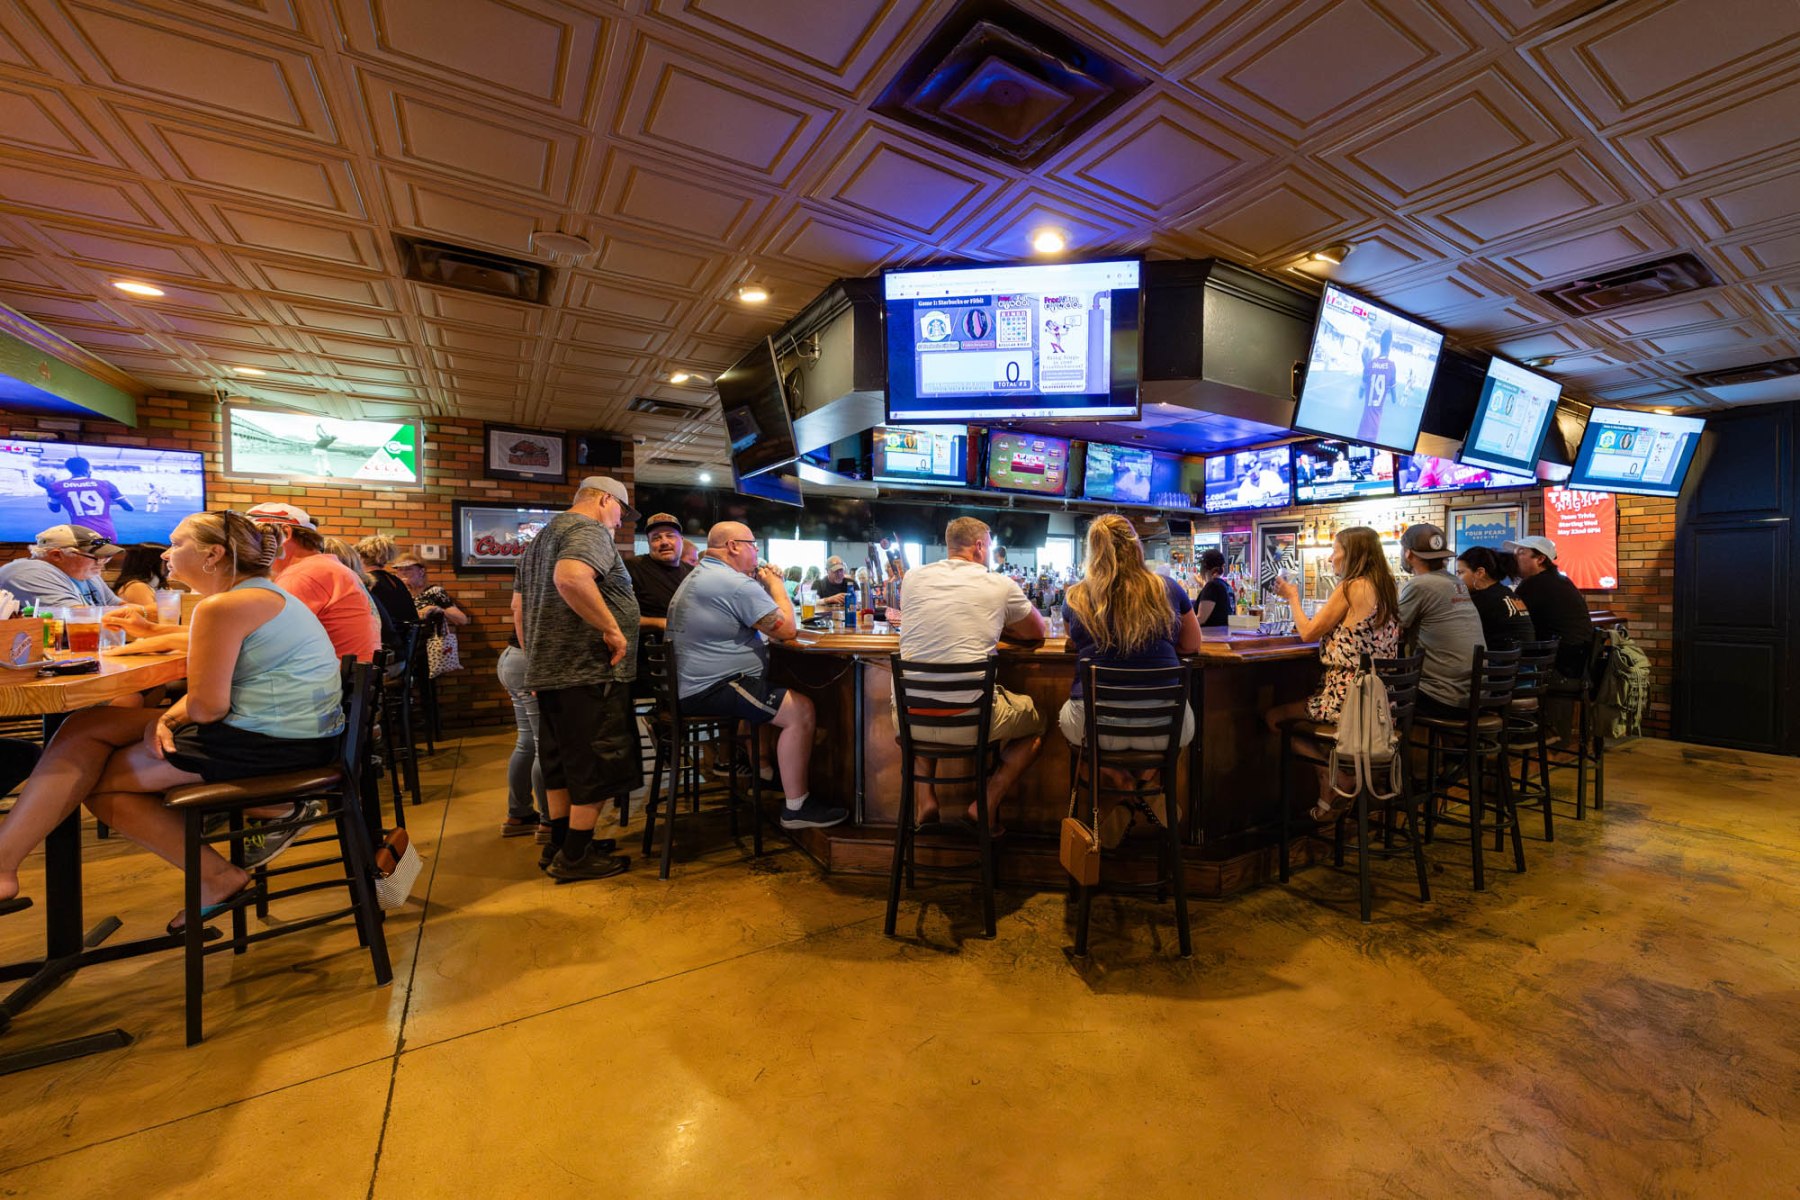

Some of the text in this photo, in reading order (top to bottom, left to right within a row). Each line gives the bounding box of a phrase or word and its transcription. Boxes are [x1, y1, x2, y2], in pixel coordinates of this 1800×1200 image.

[1367, 374, 1386, 407] 19
[68, 490, 105, 516] 19
[1555, 497, 1601, 512] NIGHT
